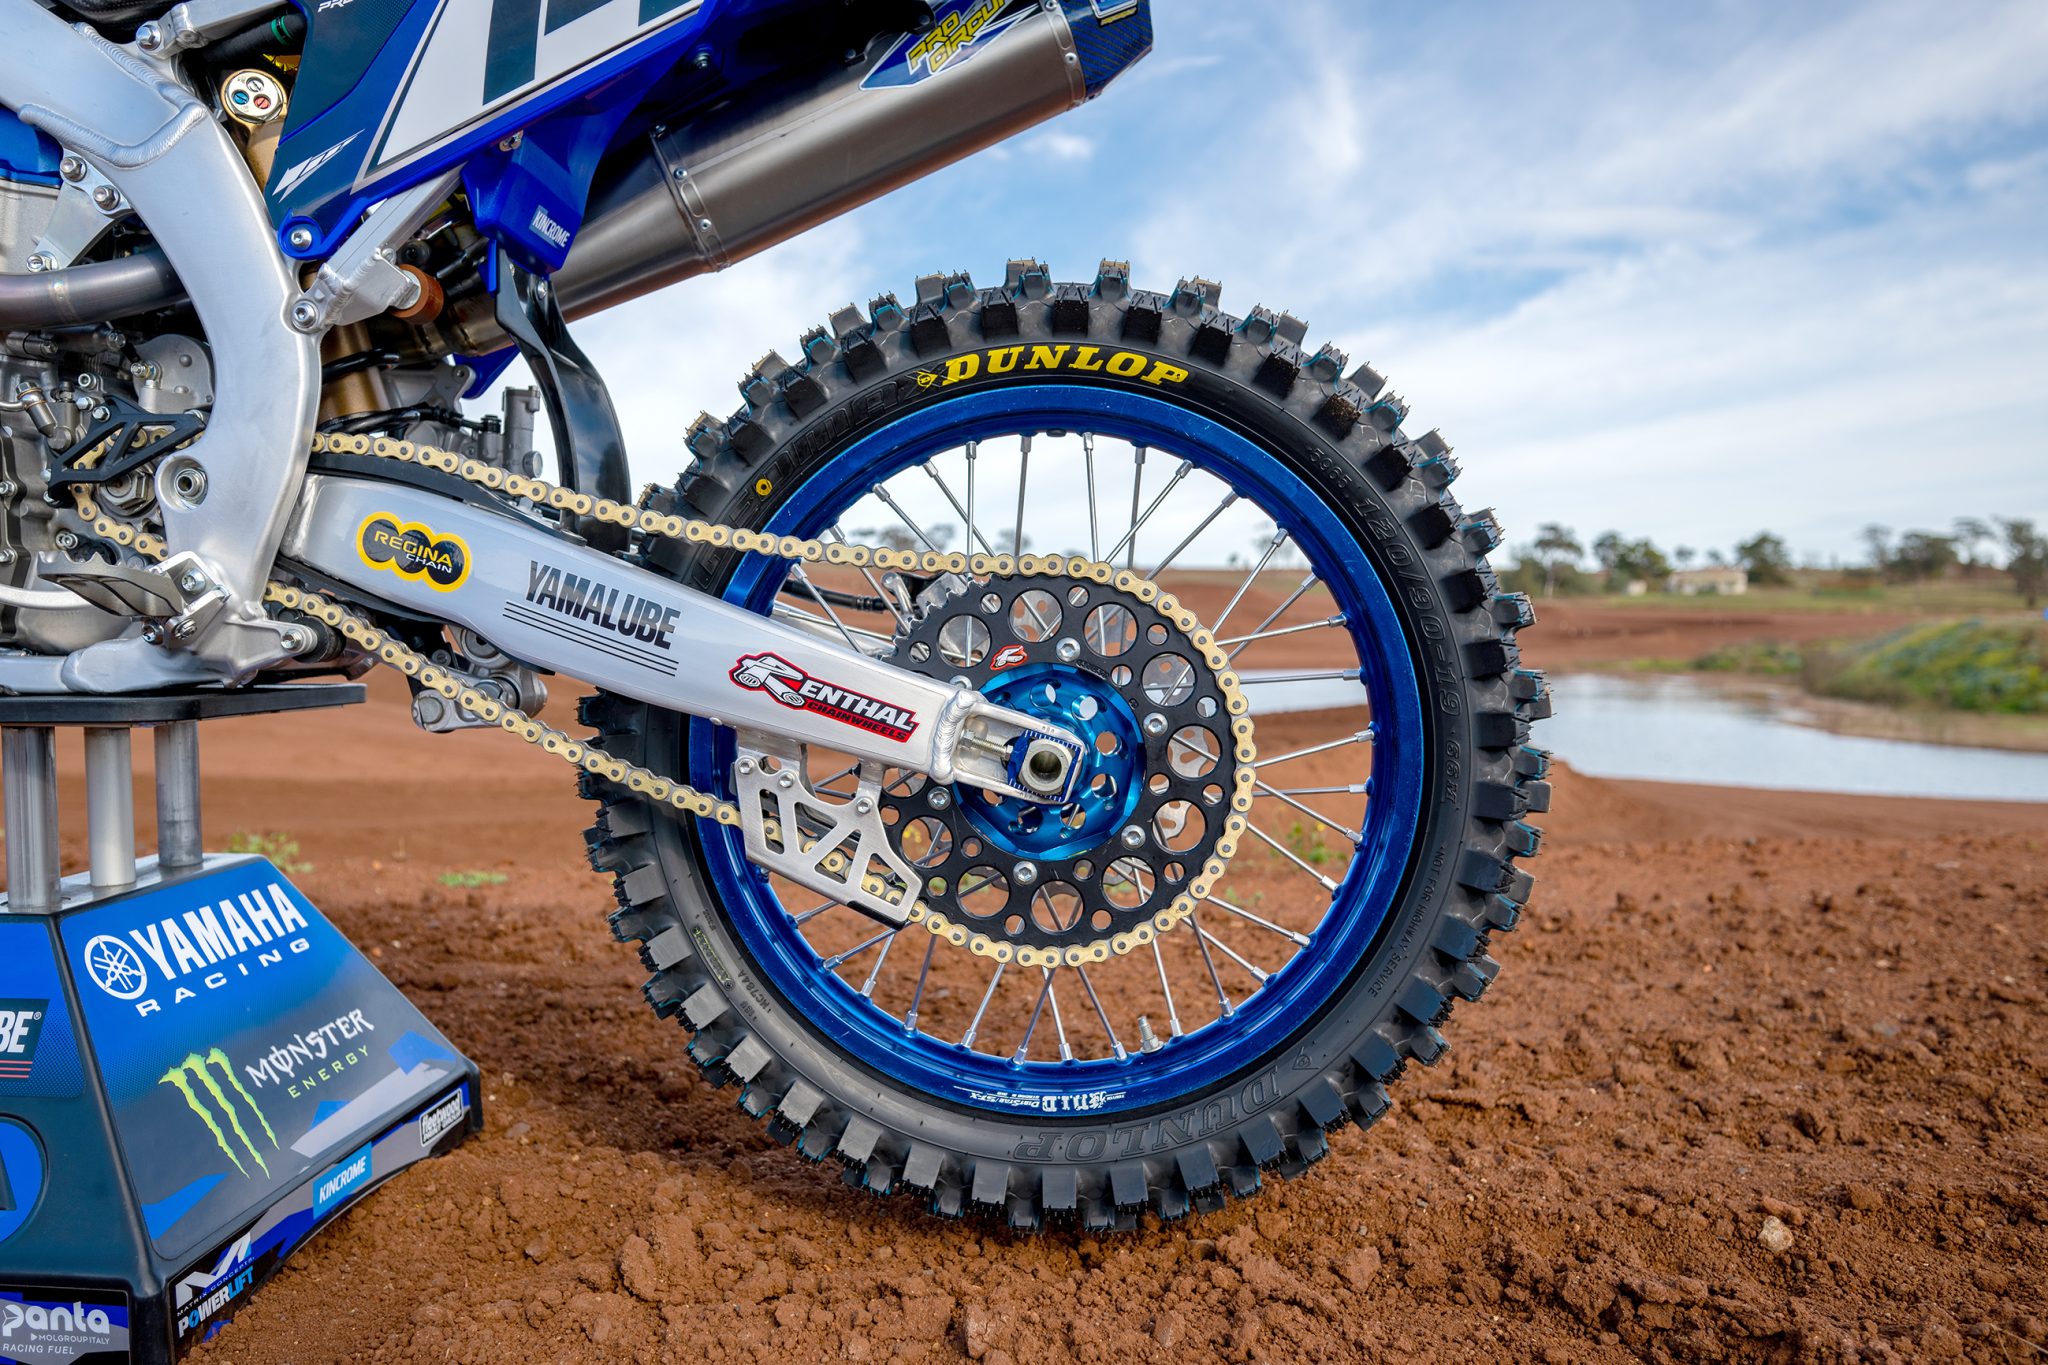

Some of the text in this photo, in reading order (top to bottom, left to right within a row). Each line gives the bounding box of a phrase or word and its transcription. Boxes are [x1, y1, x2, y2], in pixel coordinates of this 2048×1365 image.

[908, 12, 961, 70] PRO
[534, 211, 570, 247] KINCROME
[942, 344, 1190, 386] DUNLOP
[373, 529, 453, 566] REGINA
[405, 553, 453, 574] CHAIN
[526, 561, 682, 650] YAMALUBE
[734, 656, 914, 731] RENTHAL
[806, 701, 908, 741] CHAINWHEELS
[129, 883, 309, 981] YAMAHA
[1368, 851, 1445, 998] NOT FOR HIGHWAY SERVICE
[135, 937, 310, 1018] RACING
[244, 1007, 376, 1089] MONSTER
[288, 1045, 371, 1100] ENERGY
[1013, 1066, 1282, 1163] DUNLOP
[318, 1155, 368, 1205] KINCROME
[2, 1301, 110, 1337] panta
[176, 1291, 207, 1318] MATRIX
[178, 1265, 254, 1338] POWERLIFT
[2, 1344, 75, 1355] RACING FUEL
